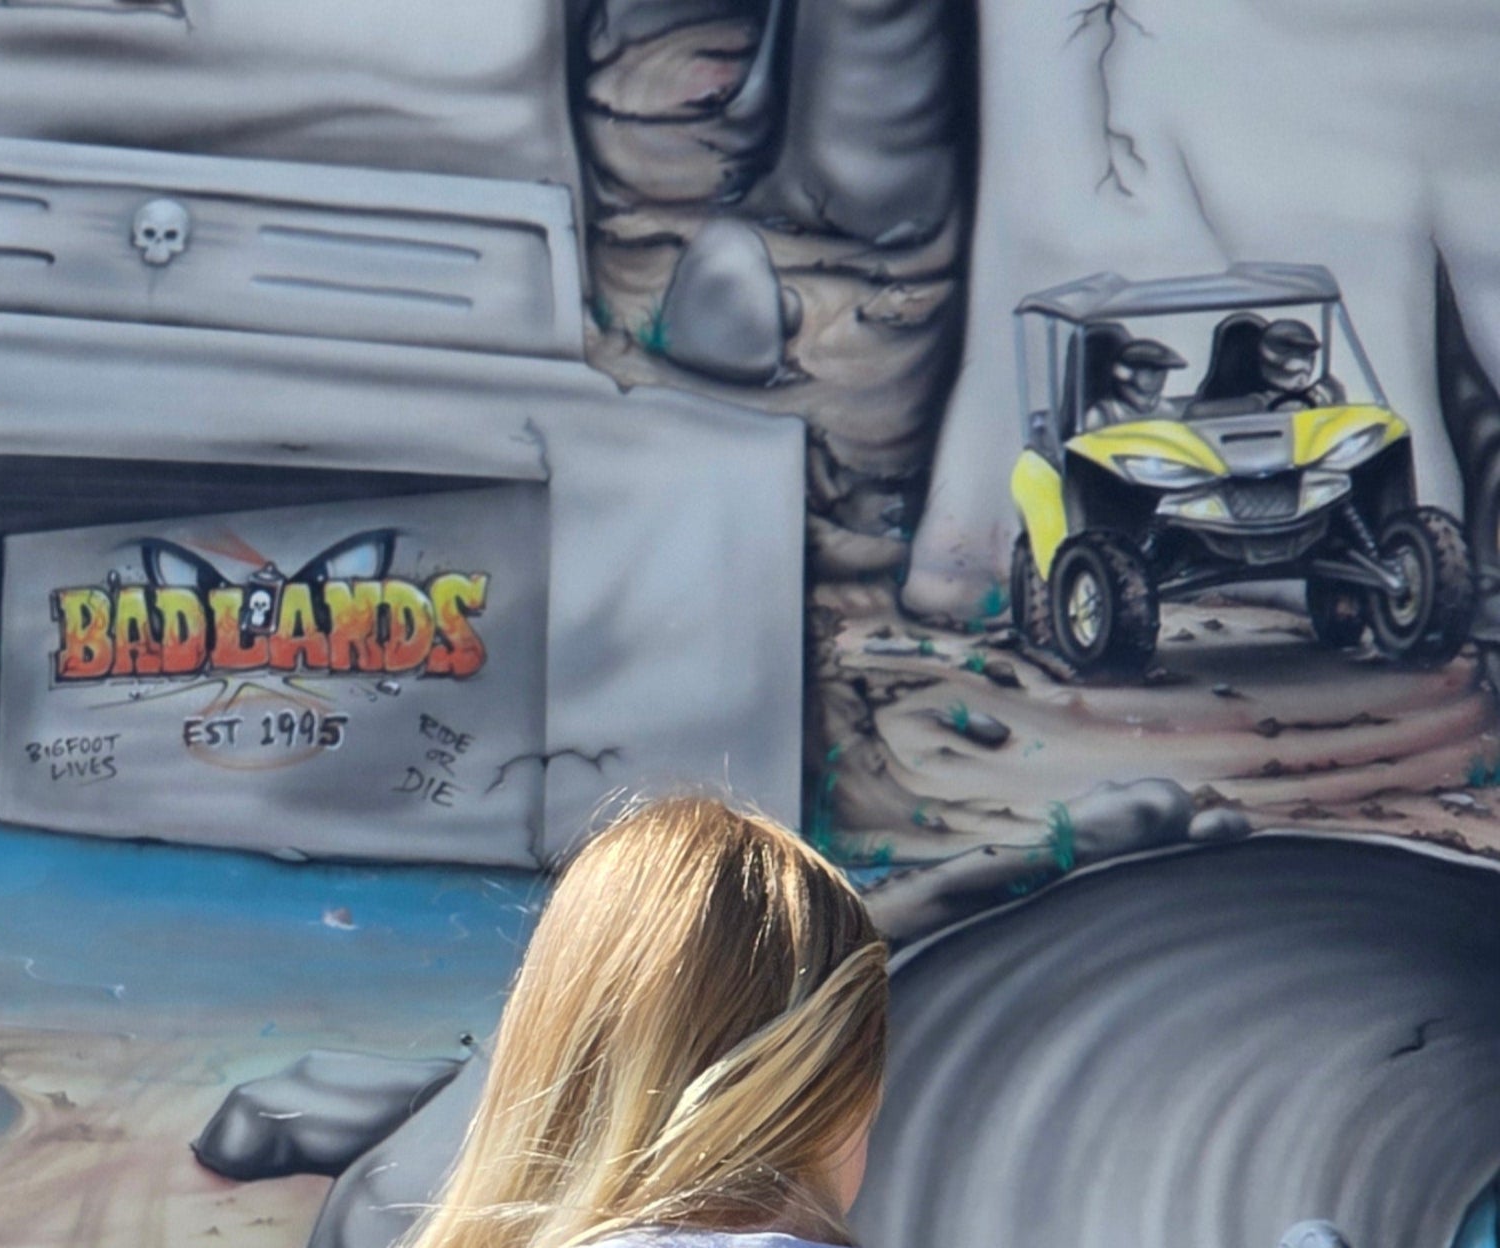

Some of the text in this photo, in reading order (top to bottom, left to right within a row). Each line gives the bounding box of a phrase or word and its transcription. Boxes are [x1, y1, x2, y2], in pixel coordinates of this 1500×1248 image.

[51, 571, 491, 684] BADLANDS
[25, 733, 121, 763] BIGFOOT
[183, 711, 348, 748] EST 1995
[419, 712, 476, 754] RIDE
[51, 756, 118, 783] LIVES
[425, 749, 456, 777] OR
[390, 766, 466, 807] DIE
